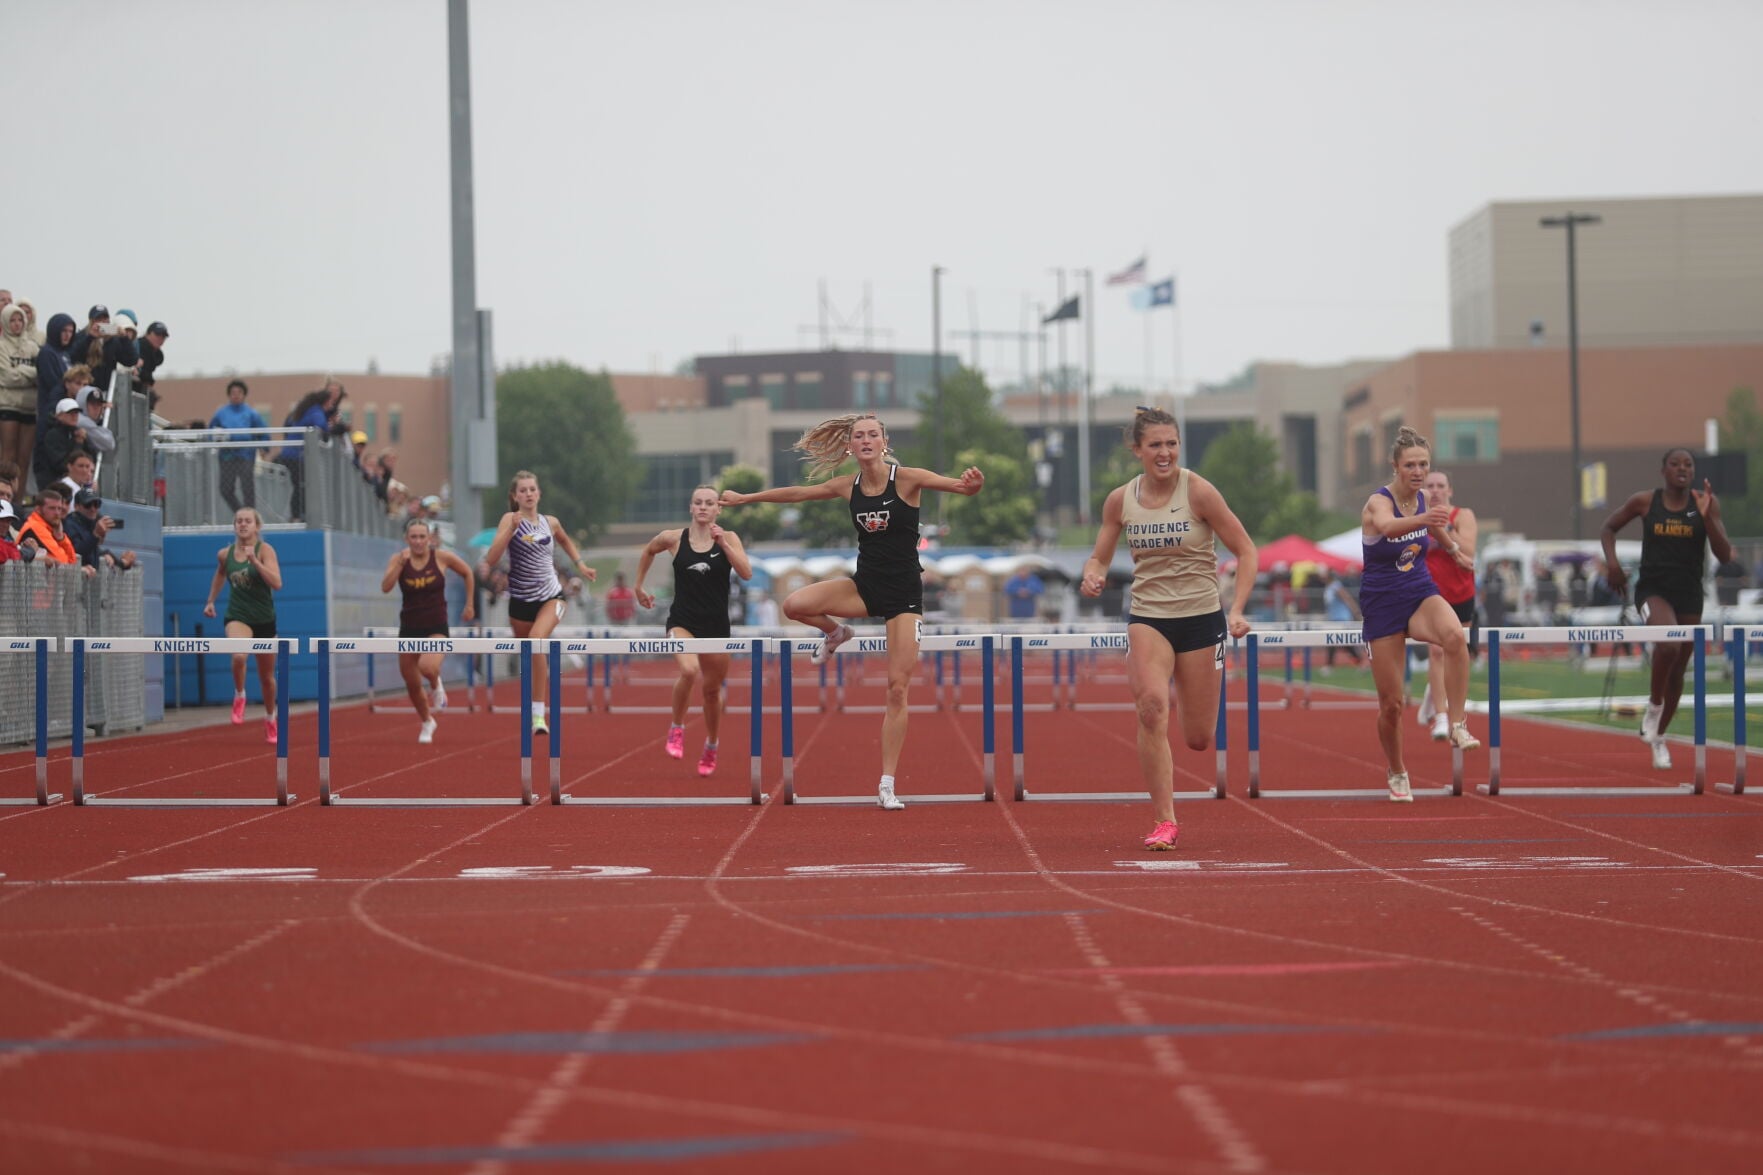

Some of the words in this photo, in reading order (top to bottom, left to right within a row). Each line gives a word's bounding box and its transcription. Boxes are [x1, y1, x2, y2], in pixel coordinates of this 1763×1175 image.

[1127, 521, 1190, 535] ROVIDENCE
[1505, 632, 1526, 640] GILL
[1568, 629, 1624, 641] KNIGHTS
[1667, 630, 1688, 638] GILL
[154, 640, 210, 652] KNIGHTS
[335, 642, 356, 650] GILL
[398, 640, 453, 652] KNIGHTS
[567, 643, 587, 651] GILL
[629, 641, 684, 653] KNIGHTS
